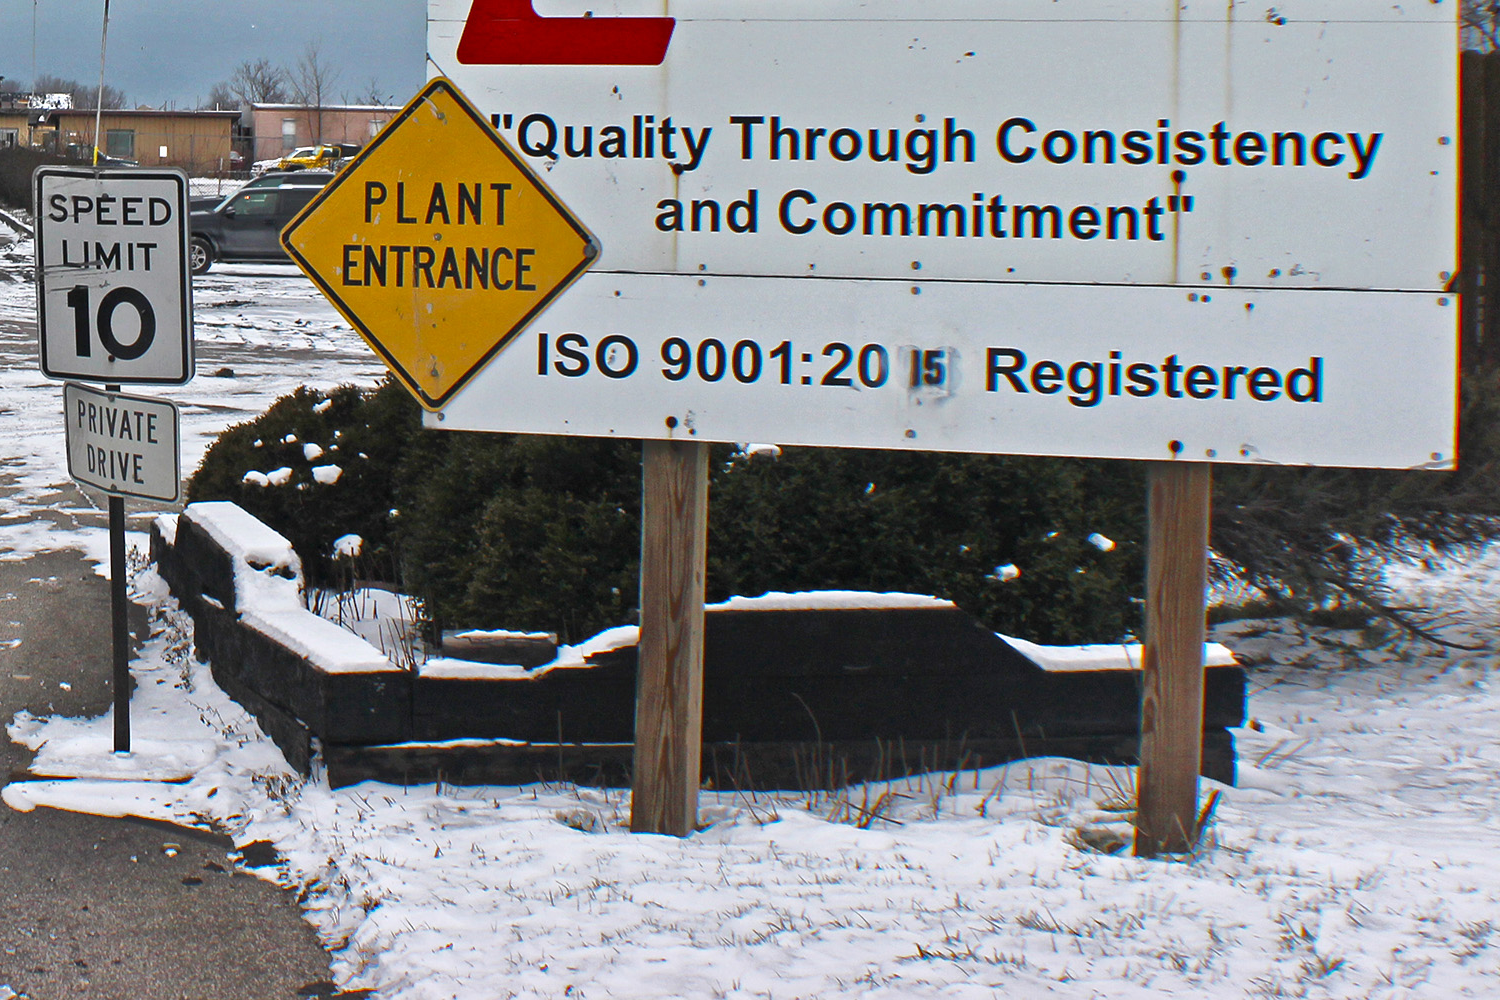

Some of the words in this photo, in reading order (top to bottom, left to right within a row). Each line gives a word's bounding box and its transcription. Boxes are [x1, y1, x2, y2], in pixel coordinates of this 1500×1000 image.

[490, 113, 713, 172] "Quality
[729, 116, 975, 175] Through
[997, 117, 1383, 180] Consistency
[48, 192, 172, 227] SPEED
[364, 180, 512, 226] PLANT
[655, 189, 758, 234] and
[779, 189, 1193, 241] Commitment"
[62, 241, 158, 272] LIMIT
[341, 244, 537, 292] ENTRANCE
[66, 284, 157, 362] 10
[538, 333, 639, 379] ISO
[986, 347, 1323, 408] Registered
[77, 399, 159, 445] PRIVATE
[86, 445, 145, 485] DRIVE
